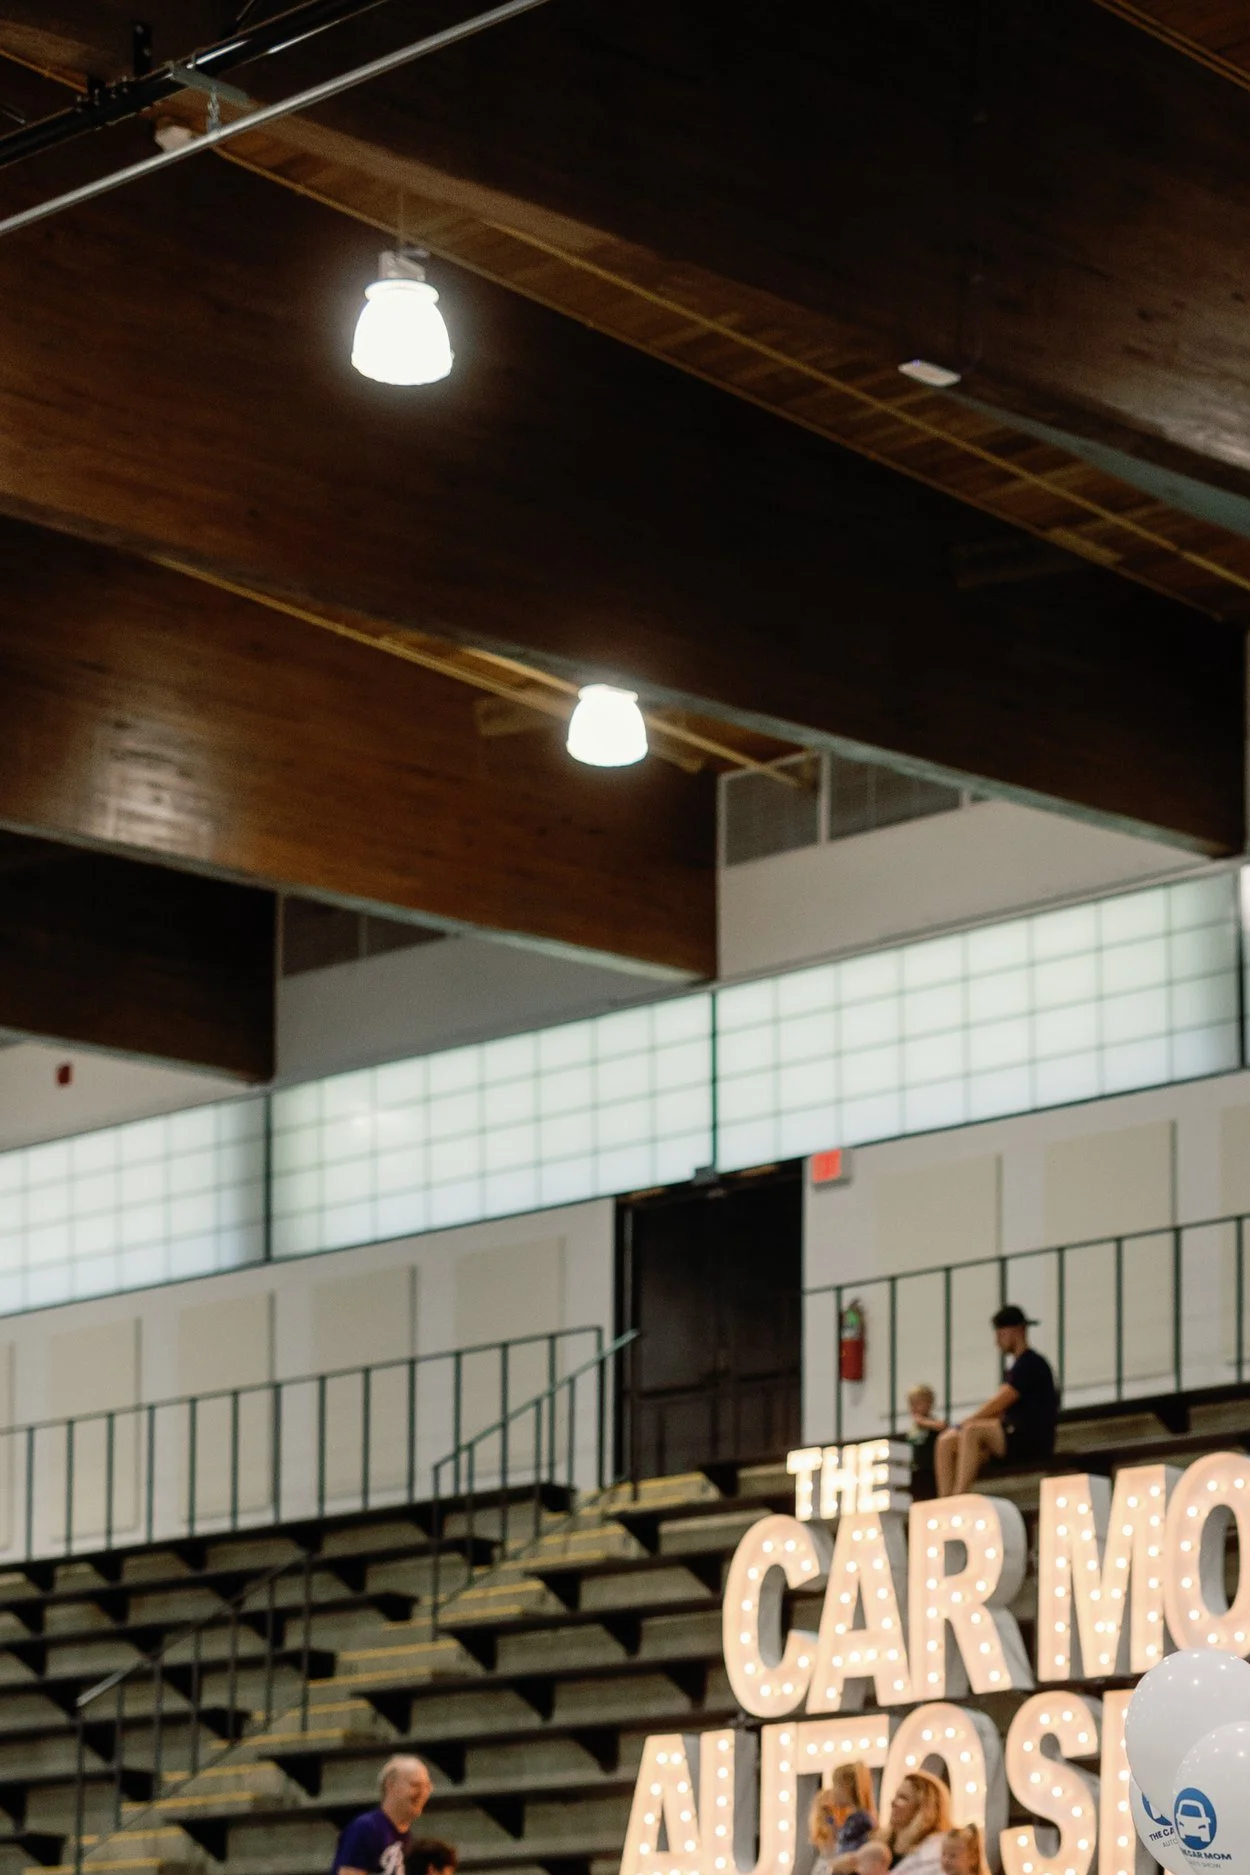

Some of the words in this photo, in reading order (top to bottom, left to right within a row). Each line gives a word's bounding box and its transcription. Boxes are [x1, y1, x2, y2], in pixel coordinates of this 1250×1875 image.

[787, 1439, 891, 1521] THE
[722, 1494, 1015, 1718] CAR
[1149, 1831, 1163, 1841] THE
[1163, 1827, 1175, 1836] CA
[1203, 1852, 1232, 1860] MOM
